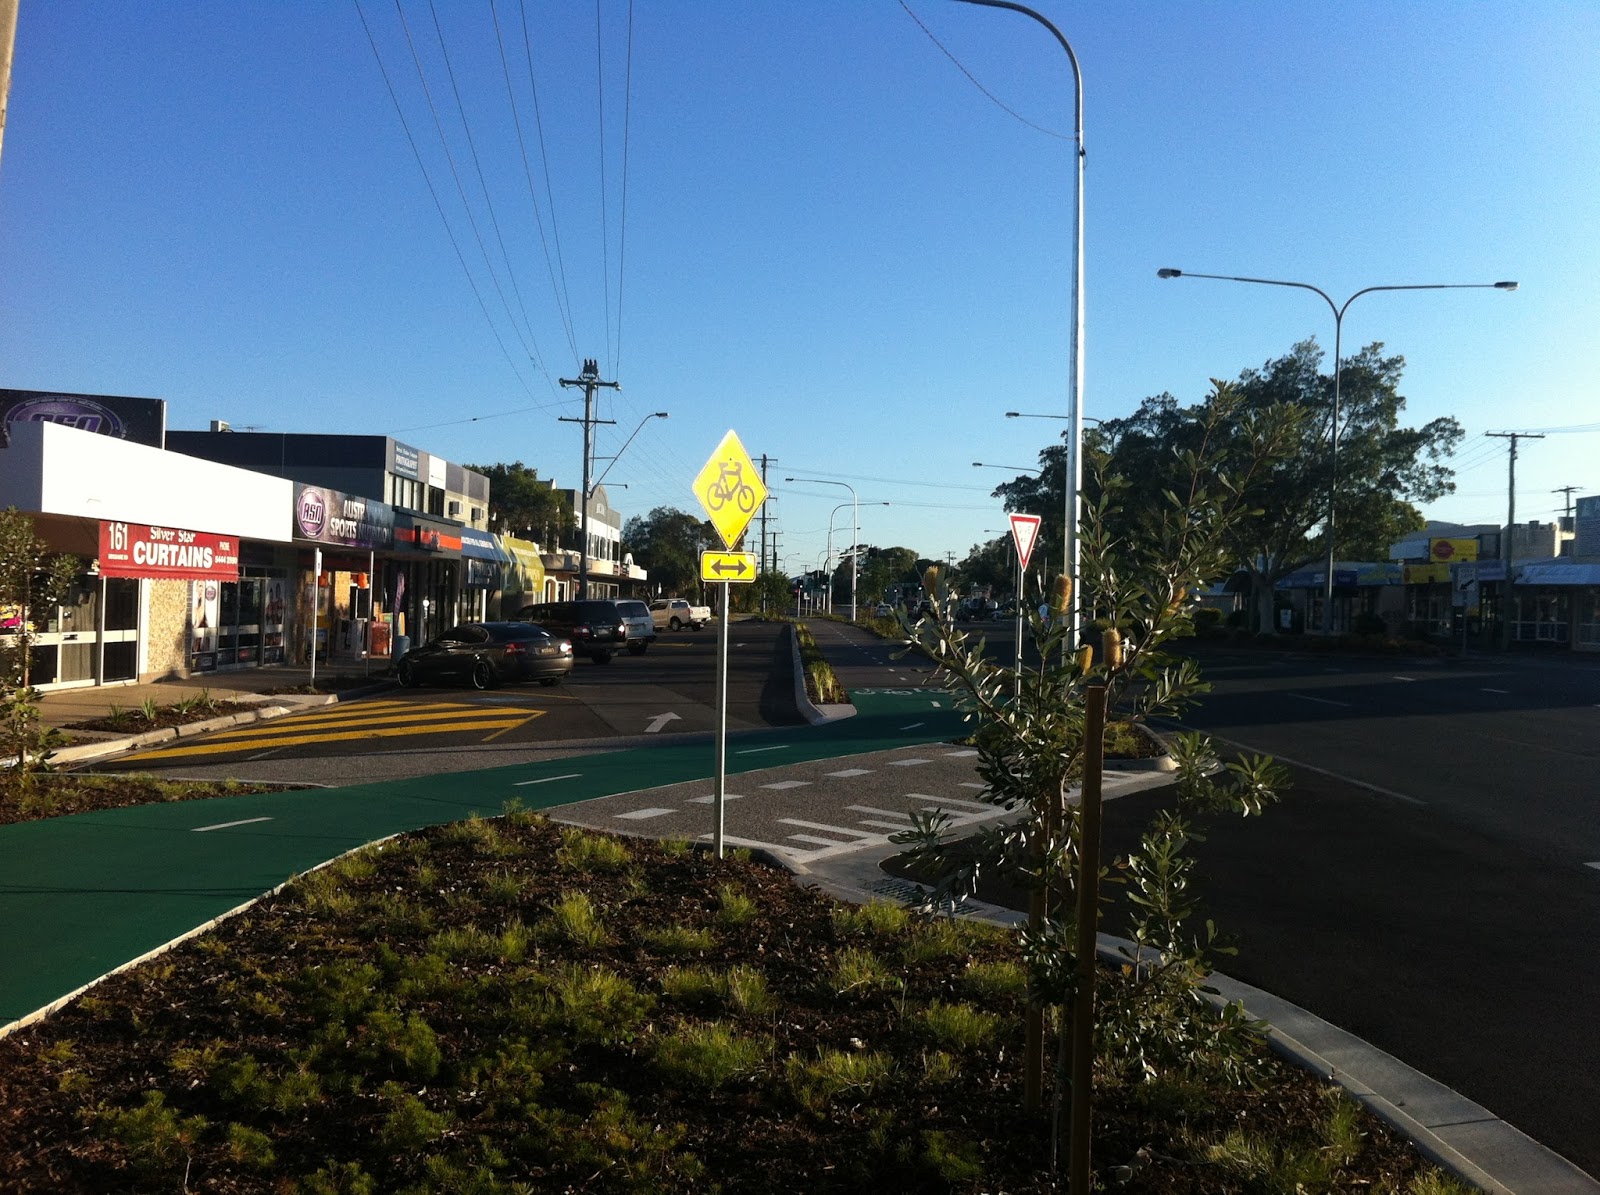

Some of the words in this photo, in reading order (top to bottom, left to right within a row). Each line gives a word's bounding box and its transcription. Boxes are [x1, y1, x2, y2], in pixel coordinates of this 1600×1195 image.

[109, 522, 128, 551] 161
[150, 526, 176, 542] Silver
[178, 529, 196, 543] Star
[330, 517, 357, 540] SPORTS
[133, 540, 213, 569] CURTAINS
